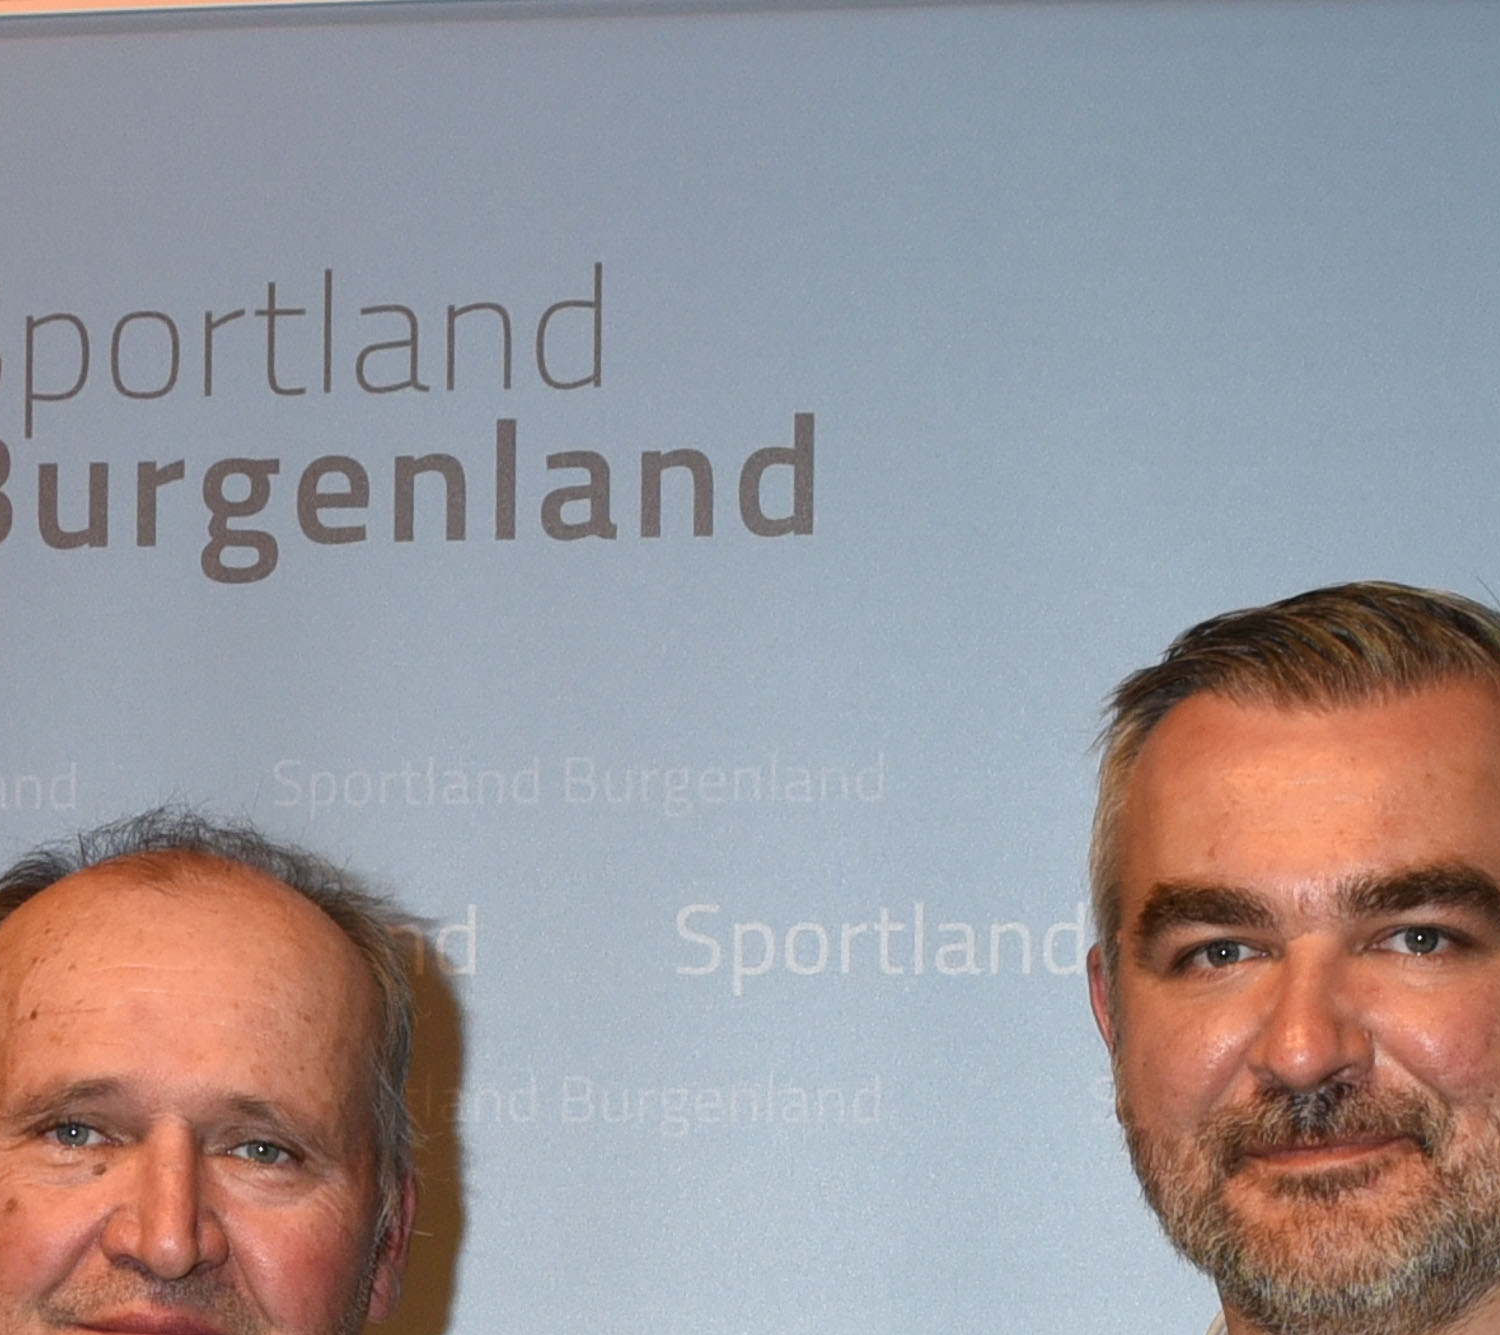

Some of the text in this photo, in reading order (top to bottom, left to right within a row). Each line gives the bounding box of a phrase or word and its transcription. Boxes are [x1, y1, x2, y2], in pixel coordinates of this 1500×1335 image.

[274, 751, 886, 820] Sportland Burgenland
[675, 900, 1089, 998] Sportland
[561, 1072, 882, 1138] Burgenland
